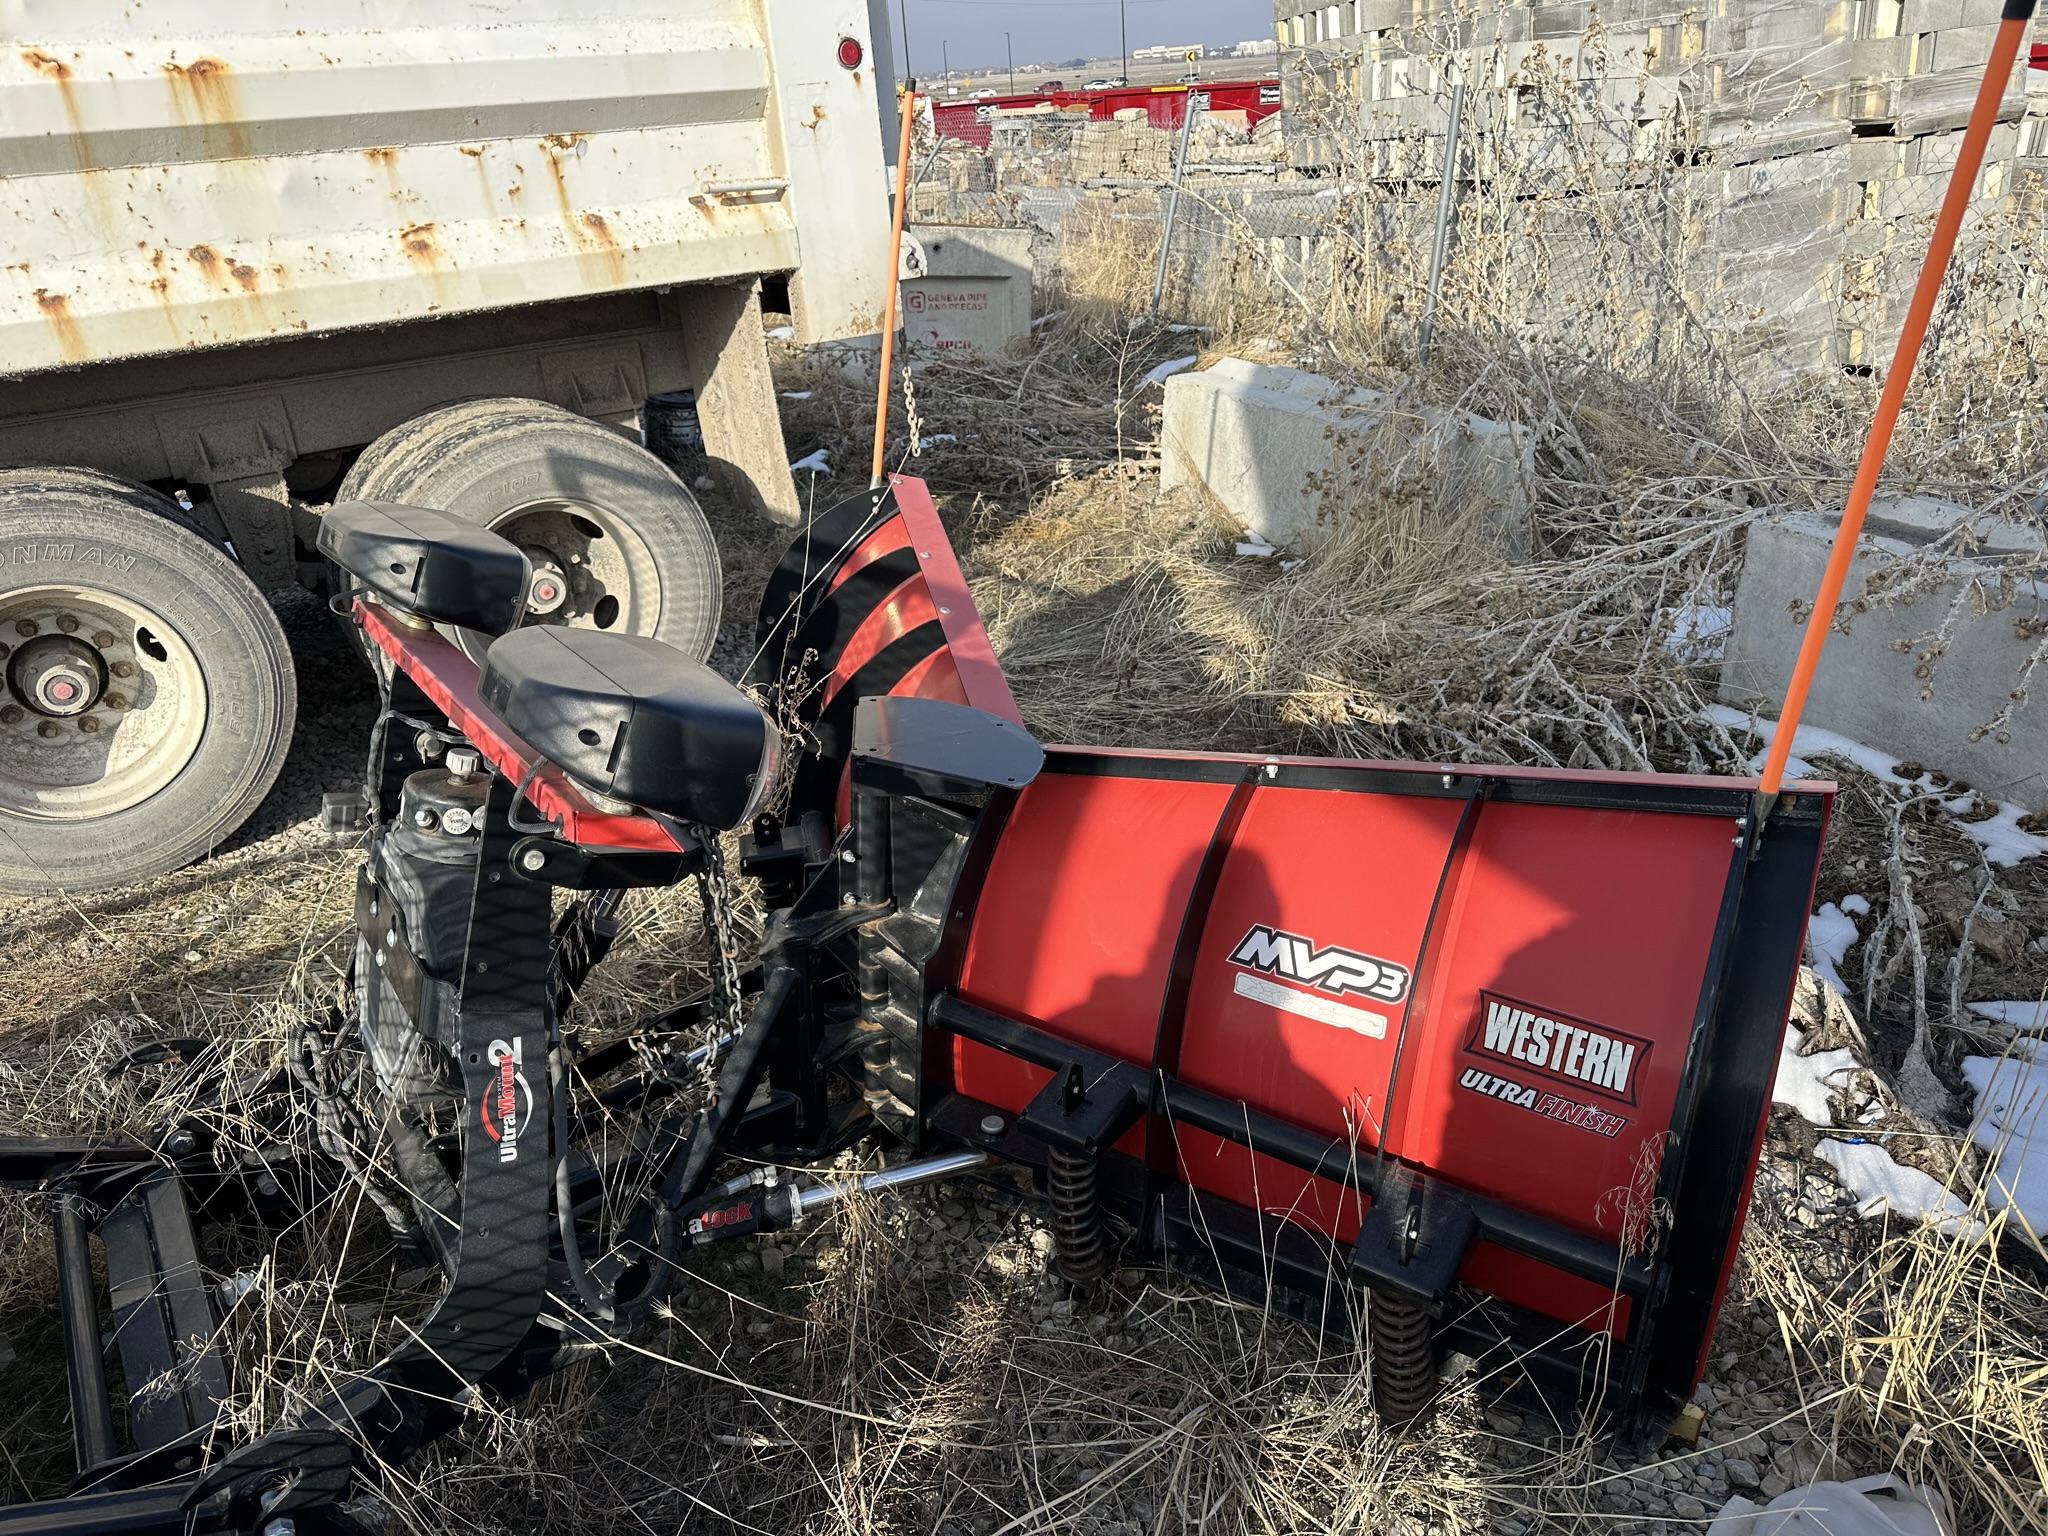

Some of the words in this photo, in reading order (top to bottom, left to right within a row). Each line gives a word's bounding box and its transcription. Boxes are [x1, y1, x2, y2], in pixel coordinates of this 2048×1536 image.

[928, 294, 965, 302] GENEVA
[967, 293, 988, 301] PIPE
[0, 544, 136, 573] NMAN
[1483, 1001, 1635, 1093] WESTERN
[1460, 1069, 1538, 1108] ULTRA
[1534, 1094, 1626, 1137] FINISH
